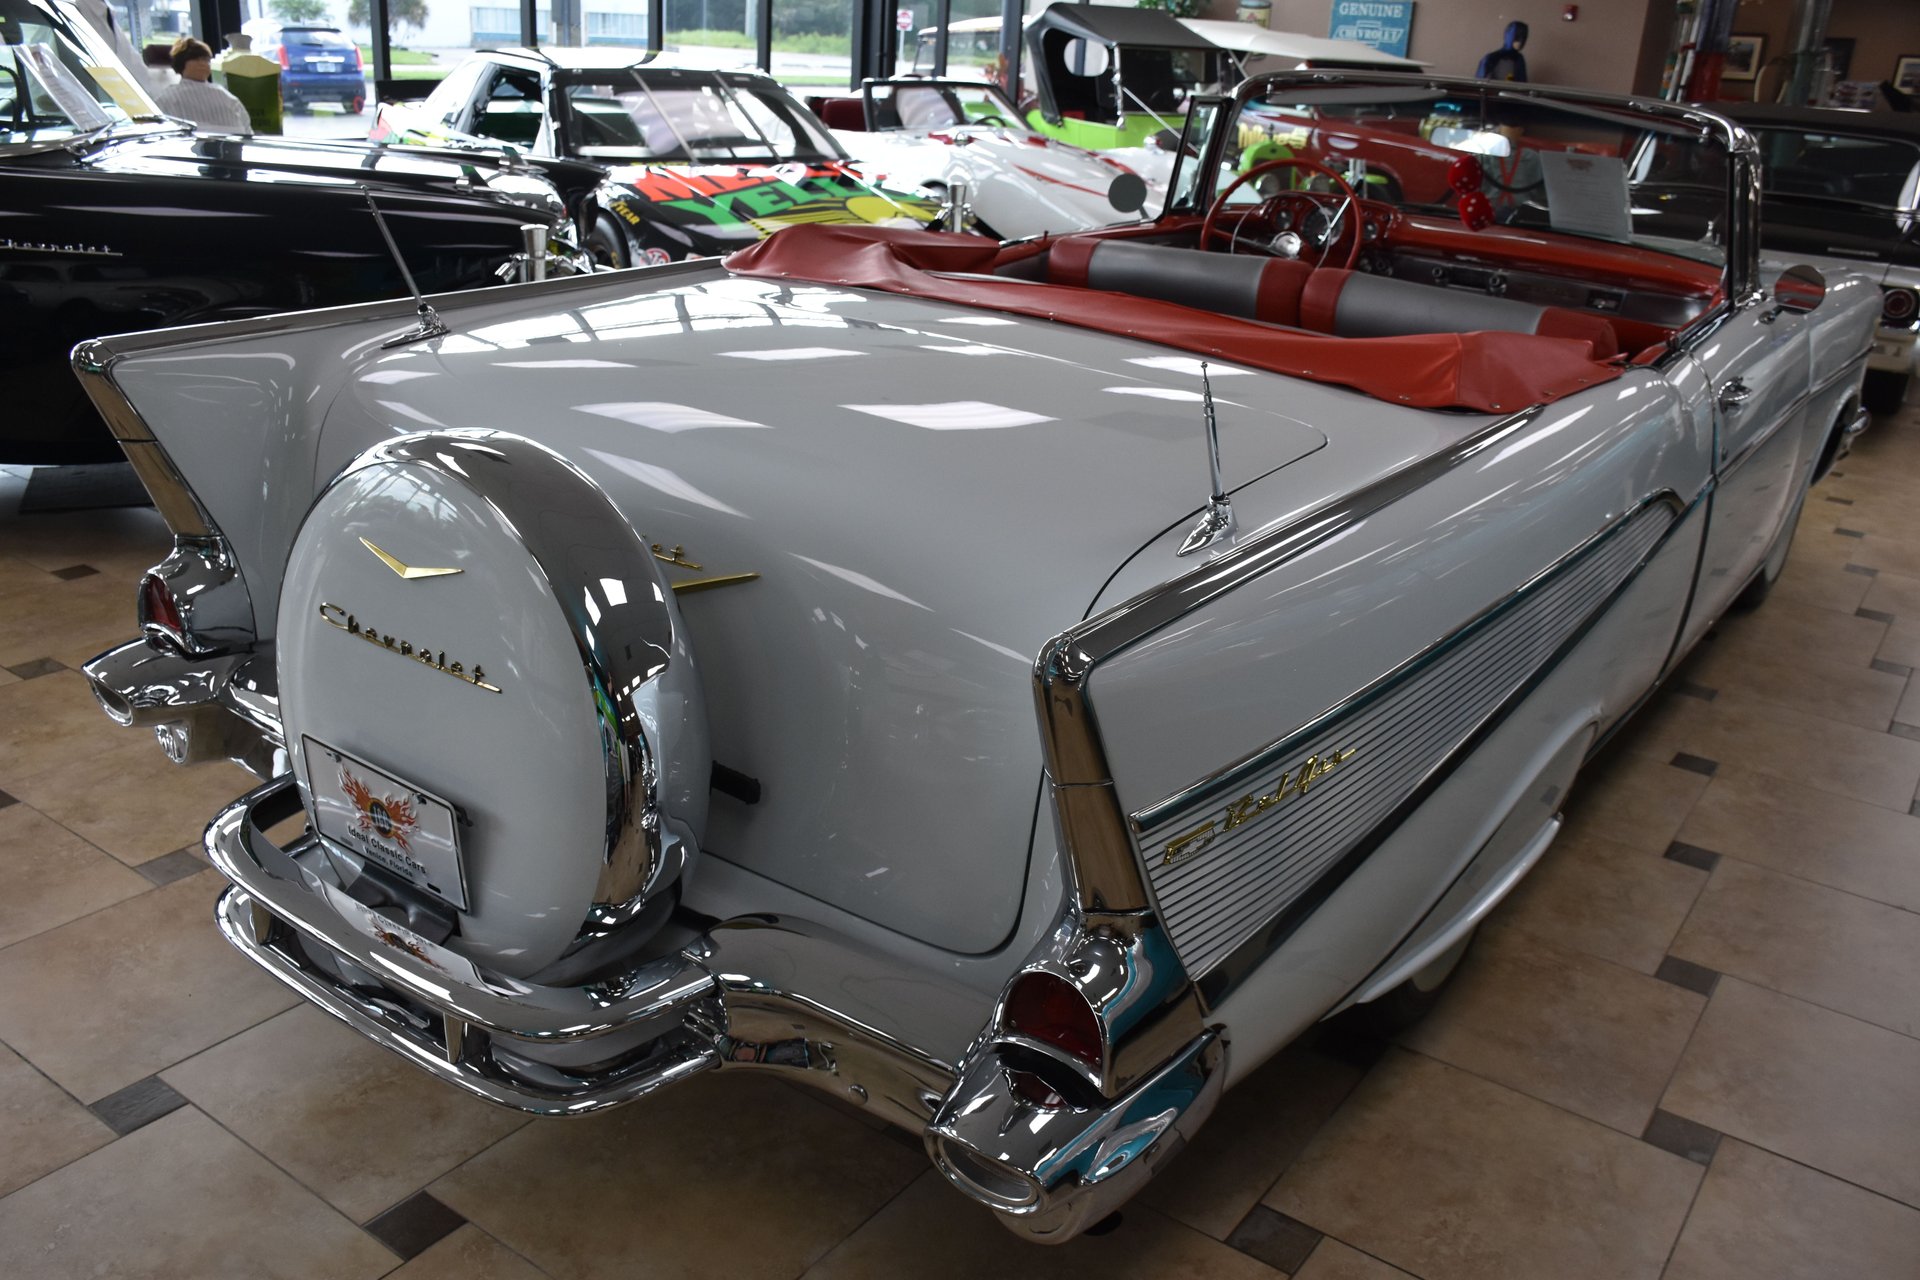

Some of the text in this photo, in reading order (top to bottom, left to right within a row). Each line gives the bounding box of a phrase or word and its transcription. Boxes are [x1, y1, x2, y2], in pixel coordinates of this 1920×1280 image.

[1339, 2, 1404, 18] GENUINE
[0, 238, 123, 257] hevrolet
[319, 601, 503, 694] Chevrolet
[348, 825, 427, 875] Ideal Classic Cars
[389, 860, 413, 877] Florida
